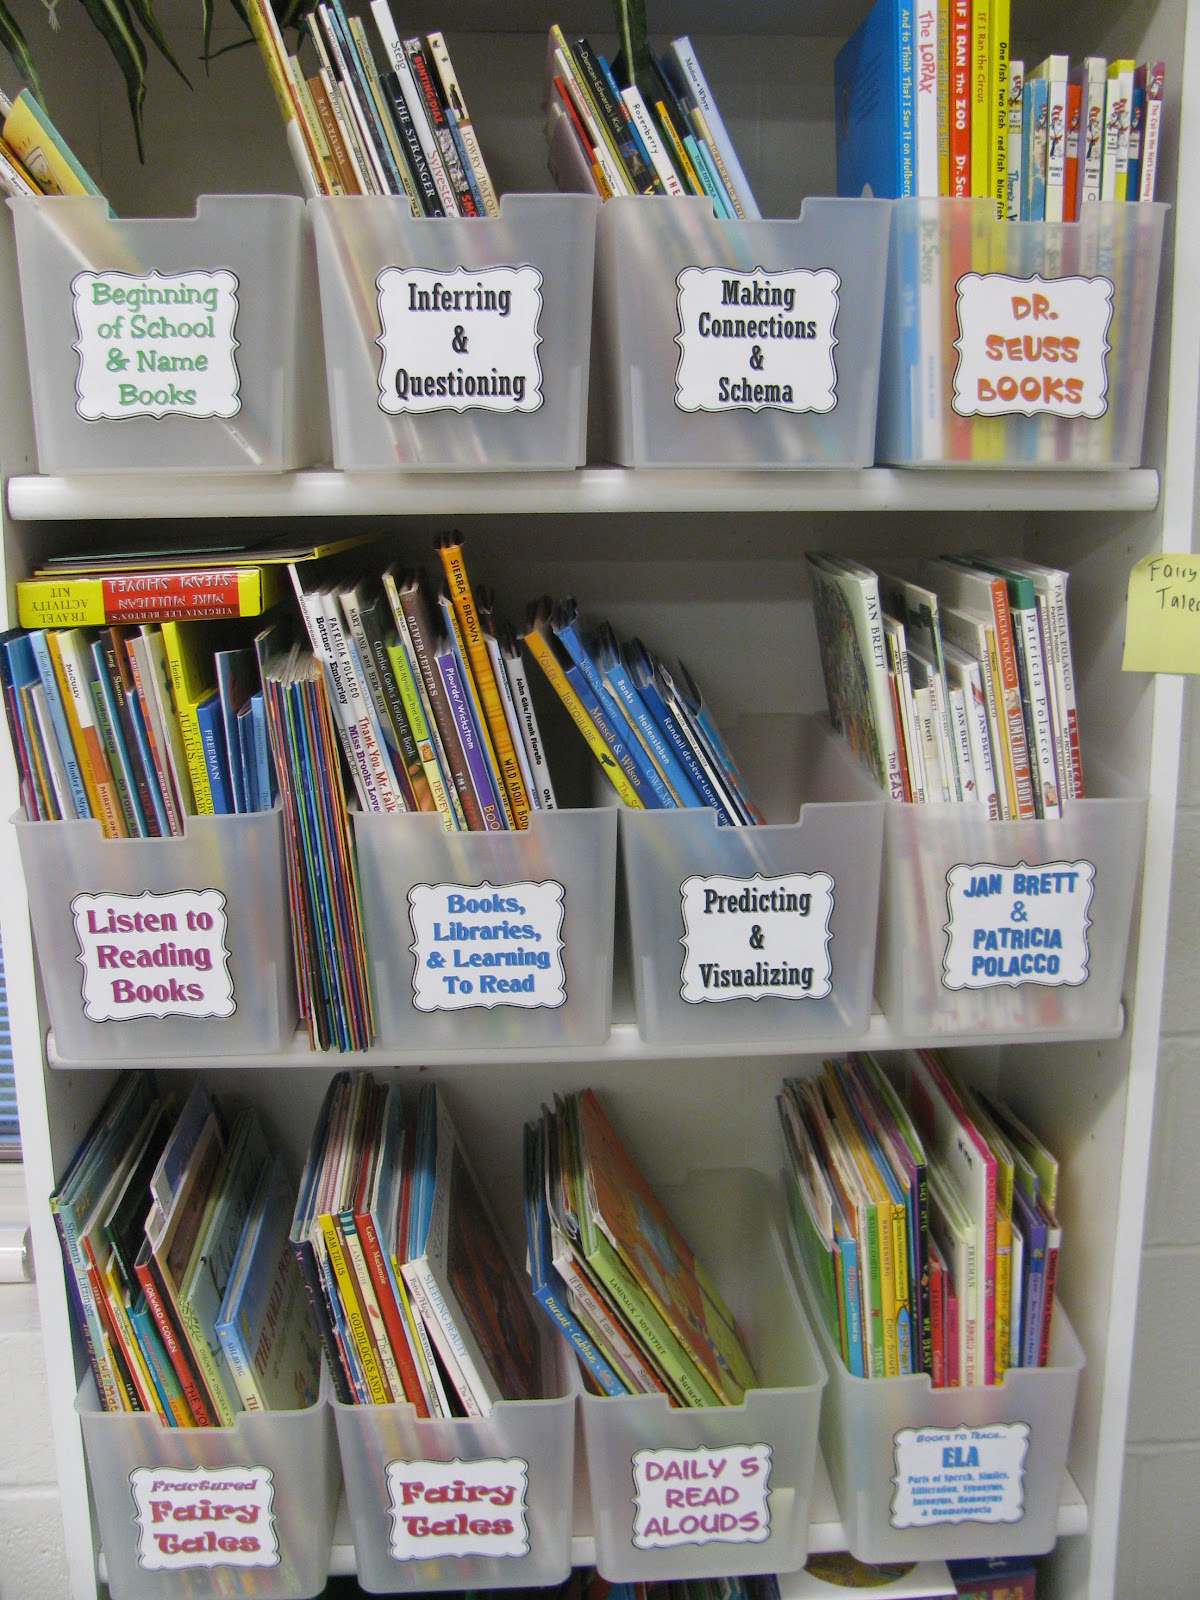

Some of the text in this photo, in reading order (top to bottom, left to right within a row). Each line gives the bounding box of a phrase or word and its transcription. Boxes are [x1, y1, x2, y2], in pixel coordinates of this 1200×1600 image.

[902, 9, 911, 28] And
[902, 31, 911, 42] to
[390, 40, 407, 71] Steig
[902, 45, 912, 73] Think
[918, 10, 936, 95] The LORAX
[956, 35, 967, 66] RAN
[976, 13, 987, 104] If Ran the Circus
[580, 51, 622, 134] Duncan Edwards Kirk
[902, 76, 912, 99] That
[956, 73, 966, 94] The
[697, 86, 711, 112] Whyte
[902, 108, 912, 128] Saw
[955, 99, 966, 130] ZOO
[632, 103, 659, 155] Rosenberry
[902, 131, 912, 140] It
[996, 42, 1008, 220] One fish two fish red fish blue fish
[395, 97, 436, 198] THE STRANGER
[902, 143, 911, 154] on
[955, 155, 966, 173] Dr.
[426, 150, 455, 210] Sylvester
[91, 282, 219, 310] Beginning
[408, 282, 512, 315] Inferring
[720, 280, 796, 311] Making
[1010, 293, 1060, 321] DR.
[97, 316, 215, 340] of School
[451, 325, 469, 353] &
[698, 313, 817, 340] Connections
[106, 349, 209, 373] & Name
[748, 345, 765, 370] &
[984, 334, 1080, 363] SEUSS
[118, 384, 198, 407] Books
[395, 369, 527, 401] Questioning
[718, 377, 794, 403] Schema
[977, 375, 1085, 404] BOOKS
[1147, 558, 1197, 583] Fairy
[31, 598, 89, 609] ACTIVITY
[50, 587, 71, 598] KIT
[38, 611, 88, 624] TRAVEL
[164, 608, 182, 617] LEE
[182, 607, 233, 616] VIRGINIA
[864, 594, 879, 621] JAN
[870, 624, 886, 670] BRETT
[994, 590, 1015, 682] PATRICIA POLACCO
[355, 632, 374, 669] JANE and
[407, 615, 425, 652] OLIVER
[419, 654, 438, 697] JEFFERS
[537, 651, 558, 684] YOLEN
[449, 558, 525, 808] SIERRA BROWN ABOUT
[516, 678, 525, 696] John
[617, 678, 635, 705] Banks
[1026, 613, 1050, 765] Patricia Polacco
[316, 615, 373, 787] Bottner Emberley Miss Brooks
[328, 617, 388, 790] PATRICIA POLACCO Thank You, Mr.
[170, 660, 202, 787] Henkes JULIUS, THE
[923, 717, 933, 742] Brett
[954, 704, 971, 765] JAN BRETT
[590, 704, 615, 743] Munsch
[621, 754, 642, 788] Wilson
[663, 716, 687, 756] Randall
[682, 750, 693, 762] de
[977, 713, 992, 773] JAN BRETT
[204, 729, 221, 781] FREEMAN
[963, 872, 1080, 898] JAN BRETT
[446, 893, 527, 915] Books,
[703, 888, 812, 917] Predicting
[1009, 900, 1028, 922] &
[86, 908, 215, 935] Listen to
[432, 920, 543, 943] Libraries,
[748, 924, 765, 950] &
[972, 927, 1062, 951] PATRICIA
[97, 945, 213, 971] Reading
[426, 948, 552, 970] & Learning
[971, 953, 1060, 977] POLACCO
[442, 974, 536, 995] To Read
[699, 960, 814, 990] Visualizing
[111, 978, 205, 1004] Books
[144, 1282, 164, 1321] FORWARD
[161, 1325, 178, 1354] COHEN
[325, 1230, 382, 1394] PAM TILLIS GOLDILOCKS AND
[423, 1273, 470, 1359] SLEEPING BEAUTY
[544, 1296, 573, 1329] Durant
[645, 1457, 728, 1482] DAILY
[941, 1445, 980, 1468] ELA
[151, 1480, 258, 1493] Fractured
[399, 1479, 517, 1506] Fairy
[665, 1486, 740, 1508] READ
[148, 1499, 262, 1524] Fairy
[644, 1510, 760, 1537] ALOUDS
[402, 1513, 515, 1538] Tales
[153, 1531, 261, 1554] Tales
